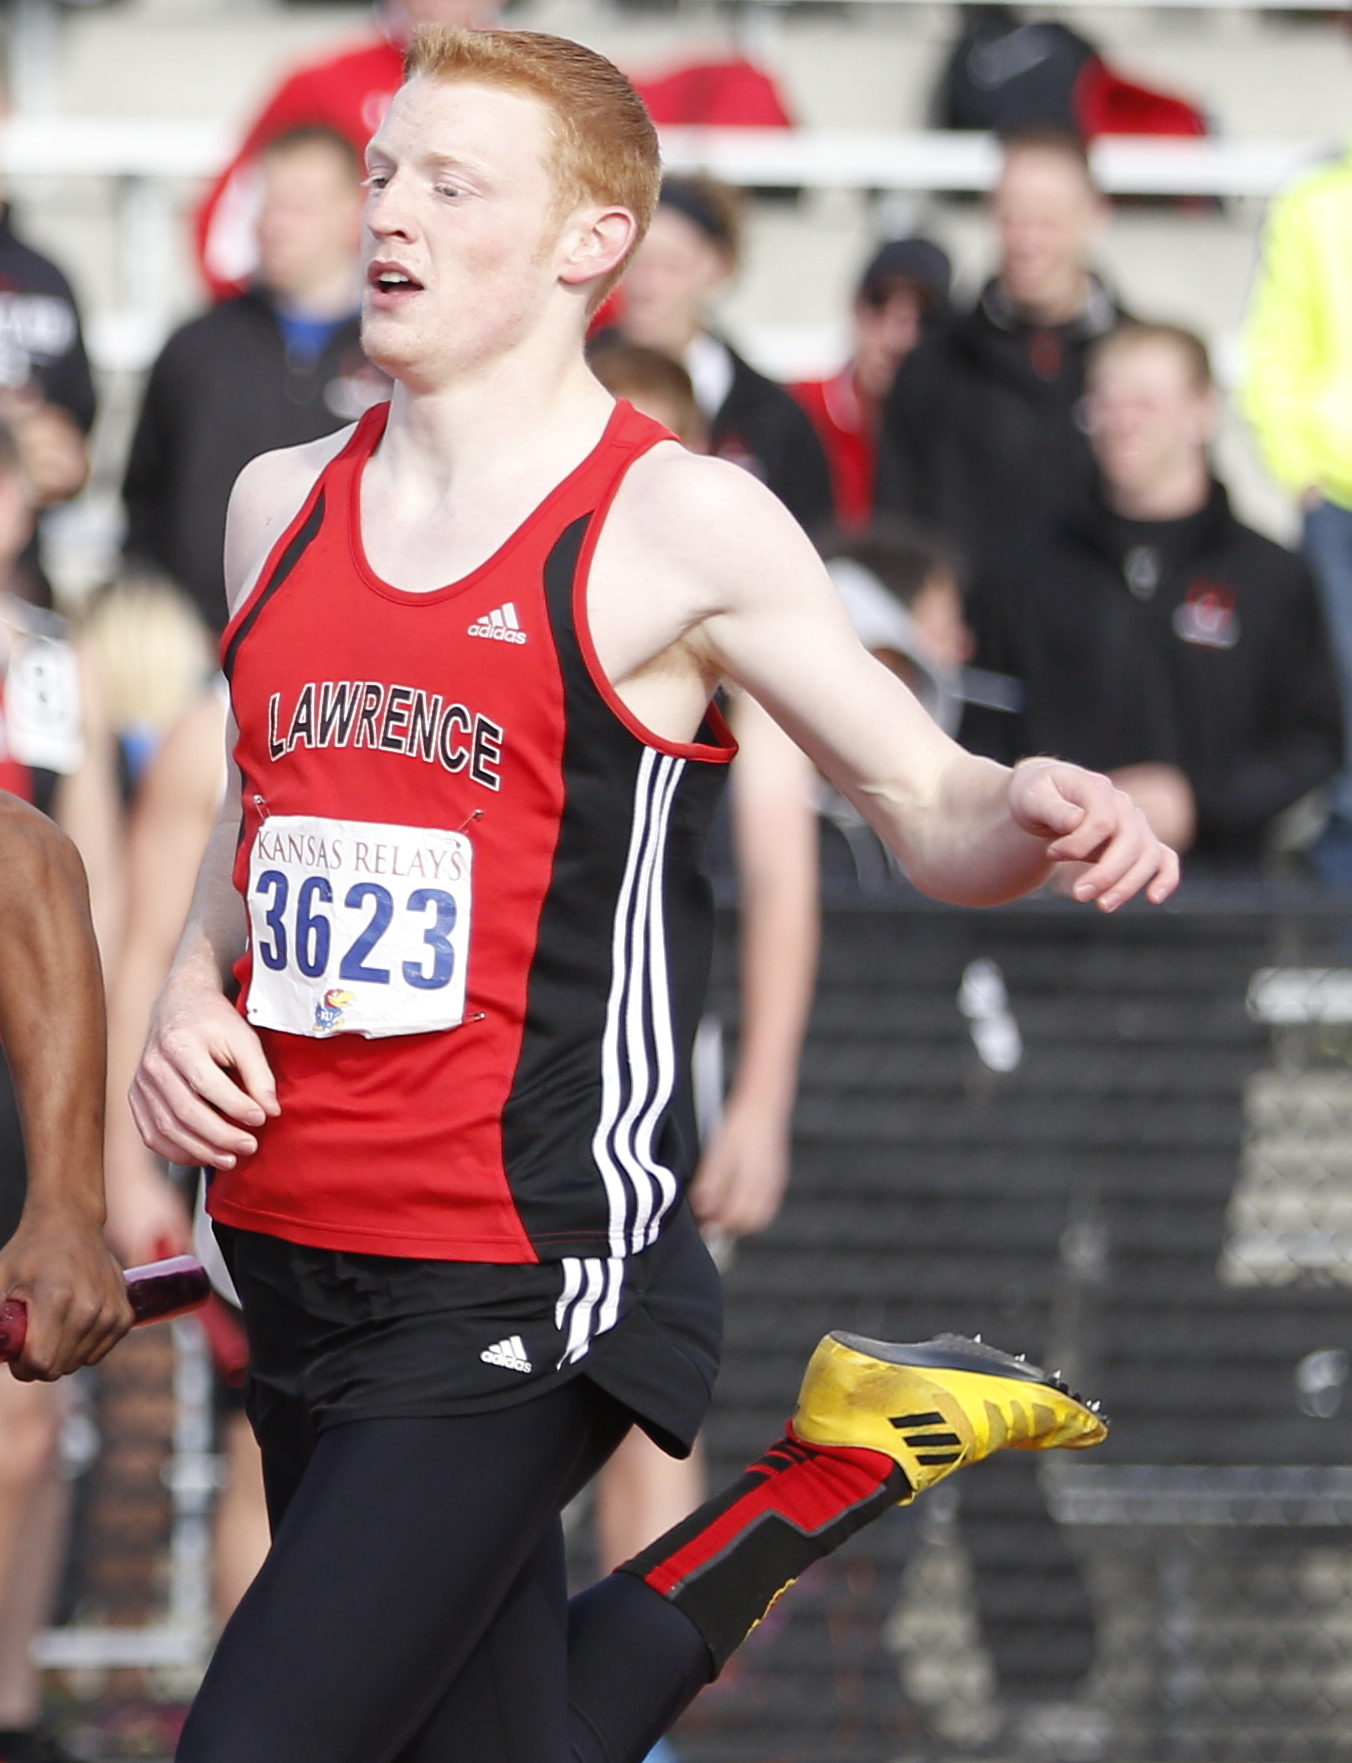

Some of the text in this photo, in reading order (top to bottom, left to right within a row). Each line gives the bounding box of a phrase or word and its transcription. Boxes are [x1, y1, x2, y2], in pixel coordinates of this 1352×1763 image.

[467, 624, 527, 645] adidas
[268, 681, 504, 792] LAWRENCE
[257, 830, 463, 882] KANSAS RELAYS
[256, 869, 458, 991] 3623
[480, 1350, 532, 1374] adidas
